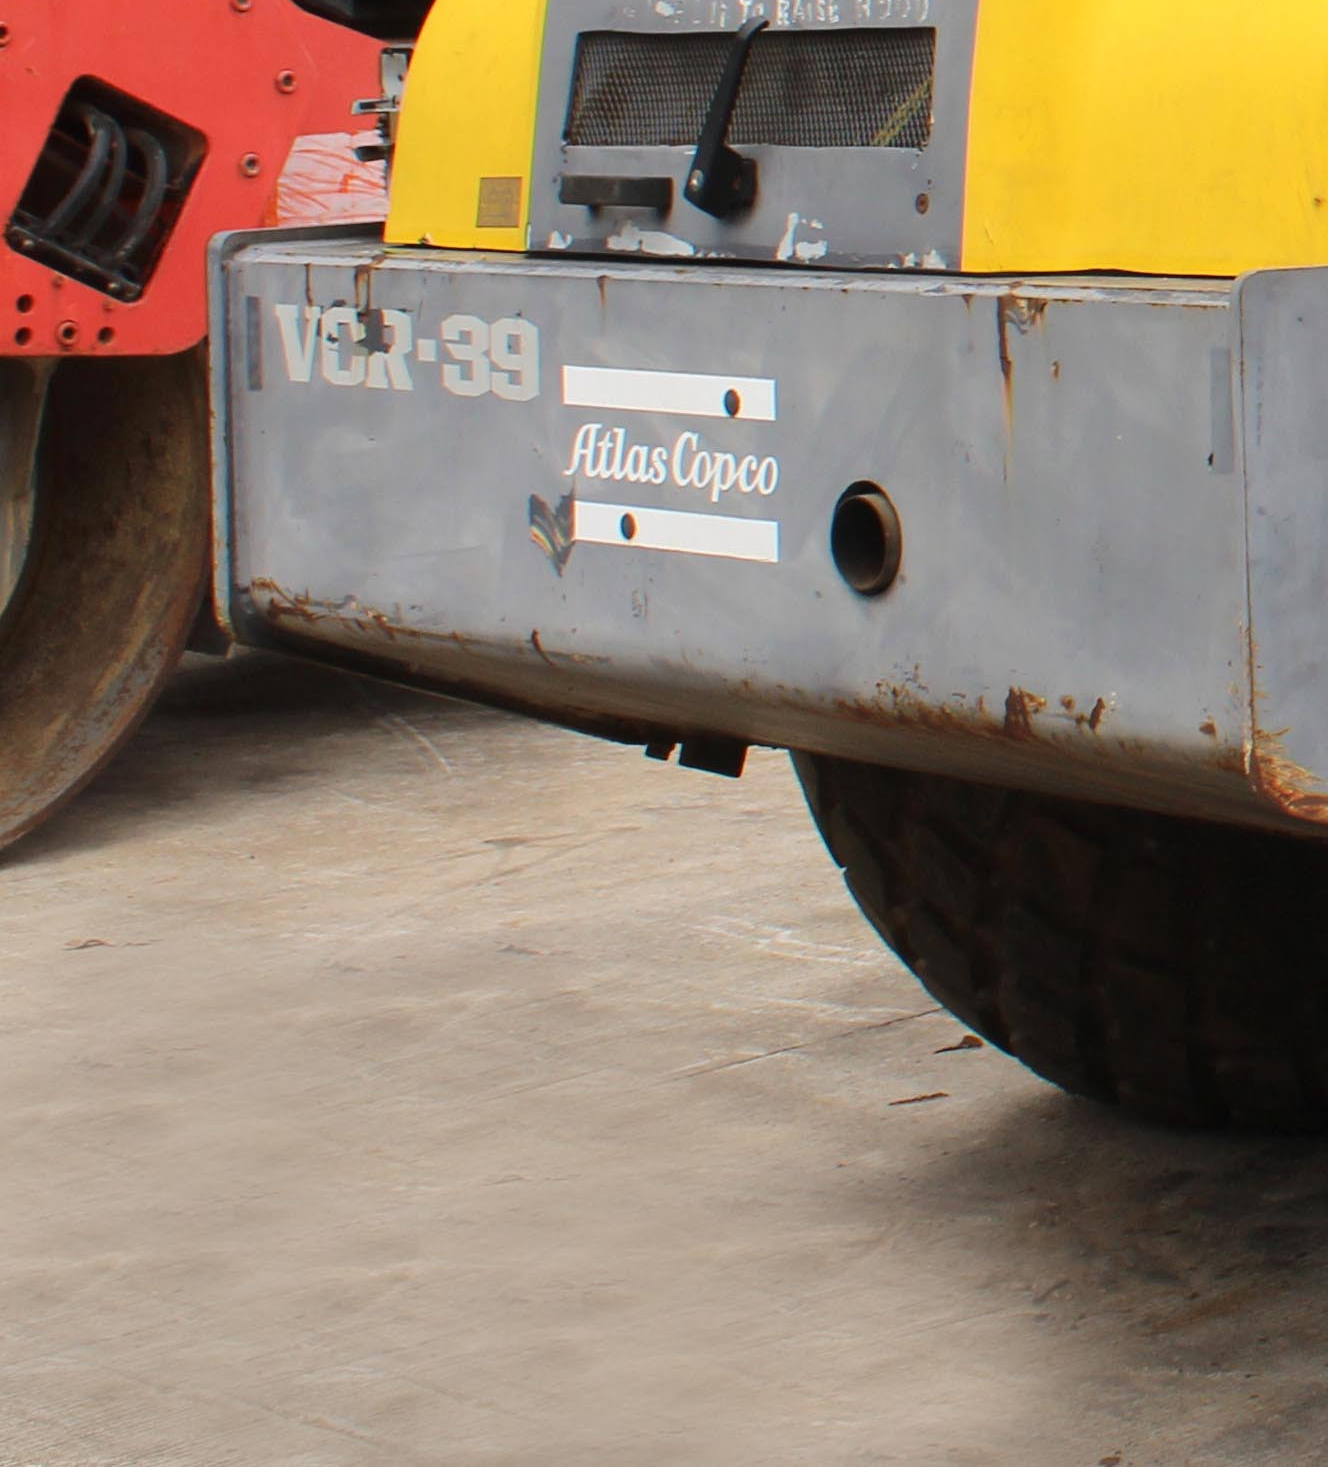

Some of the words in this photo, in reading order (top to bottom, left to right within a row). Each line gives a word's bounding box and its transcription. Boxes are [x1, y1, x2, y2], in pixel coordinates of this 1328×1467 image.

[275, 302, 541, 402] VCR-39
[564, 422, 669, 486] Atlas
[671, 430, 779, 502] Copco
